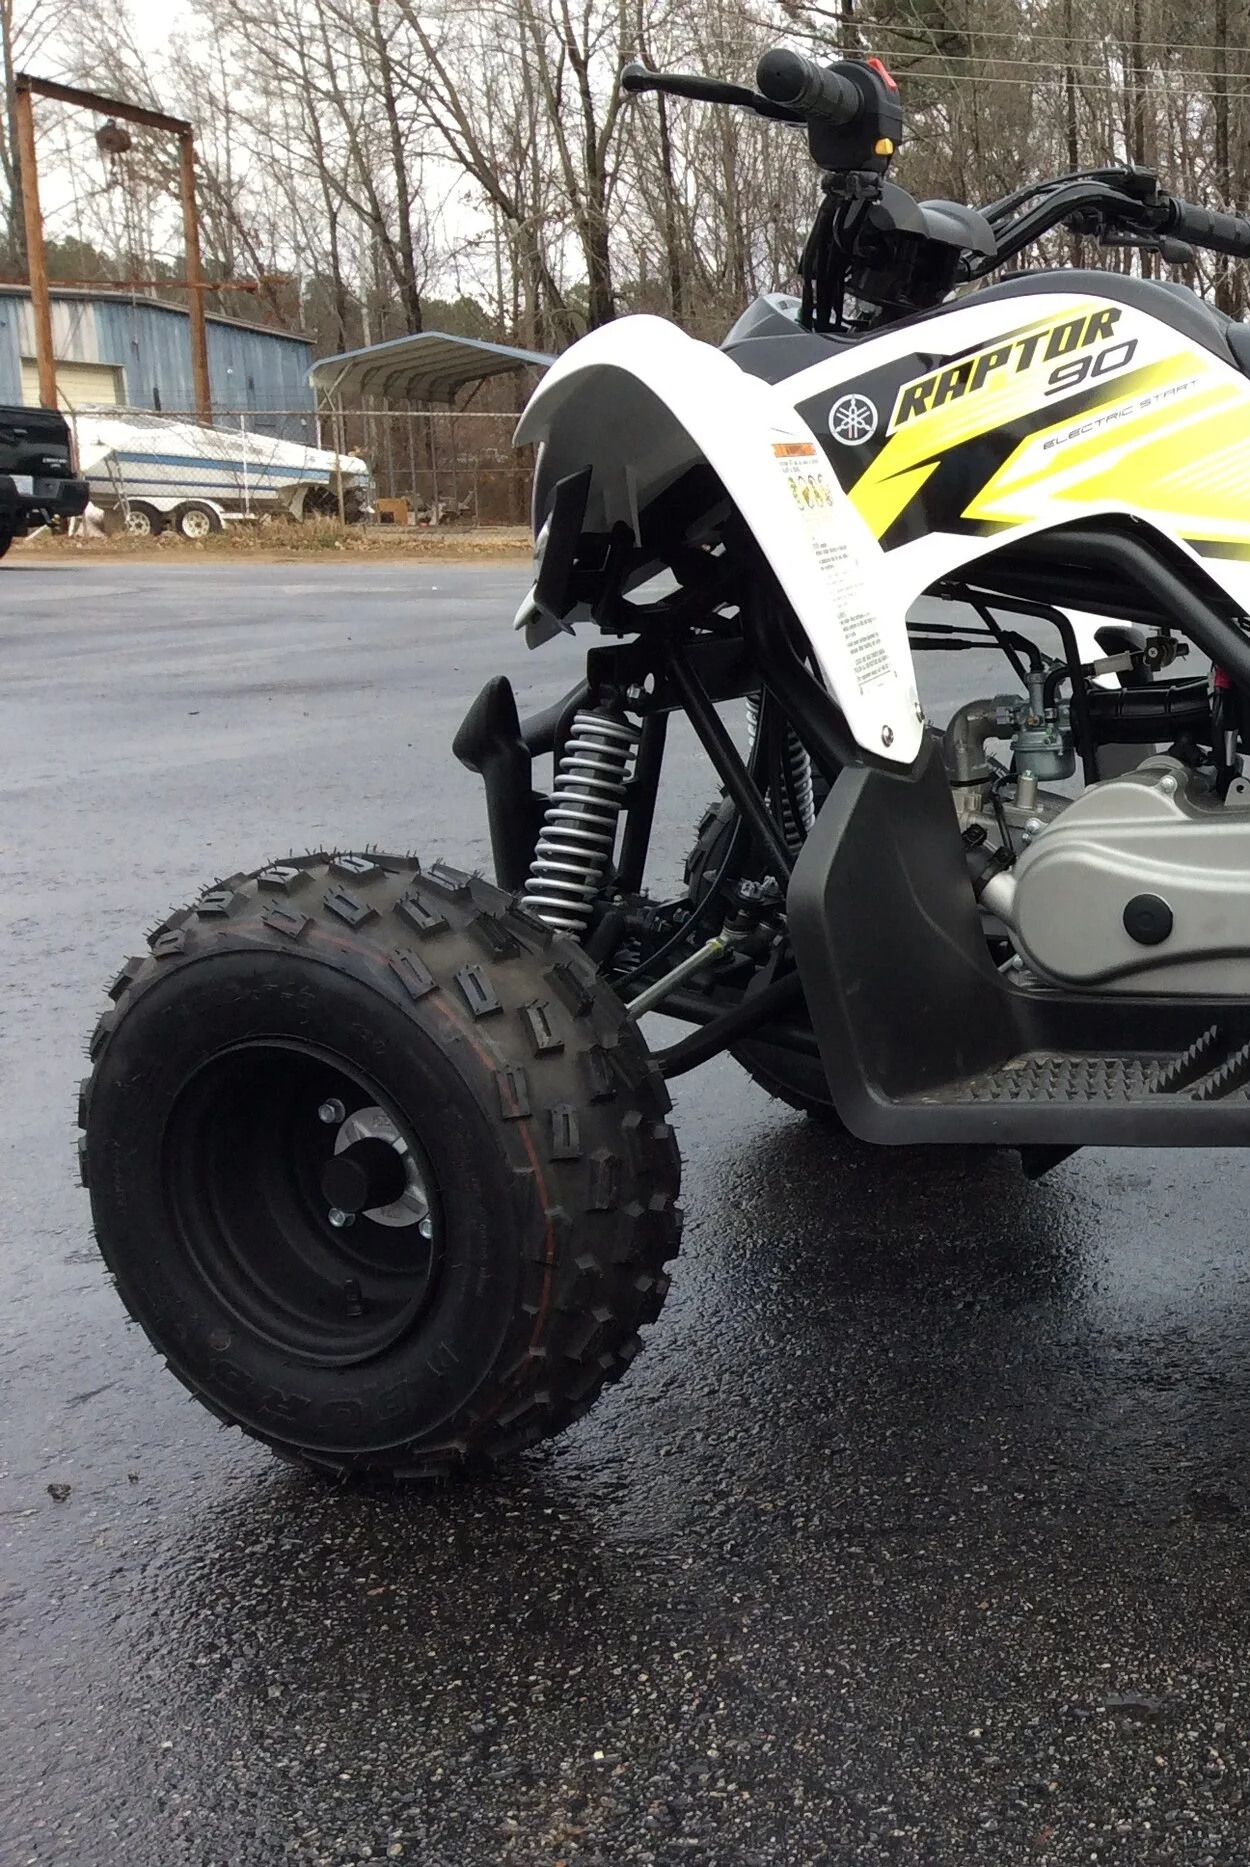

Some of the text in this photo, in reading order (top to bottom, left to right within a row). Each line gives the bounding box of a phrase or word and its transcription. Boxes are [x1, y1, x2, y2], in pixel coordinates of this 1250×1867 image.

[895, 307, 1122, 426] RAPTOR
[1044, 338, 1138, 397] 90
[1043, 380, 1198, 450] ELECTRIC START
